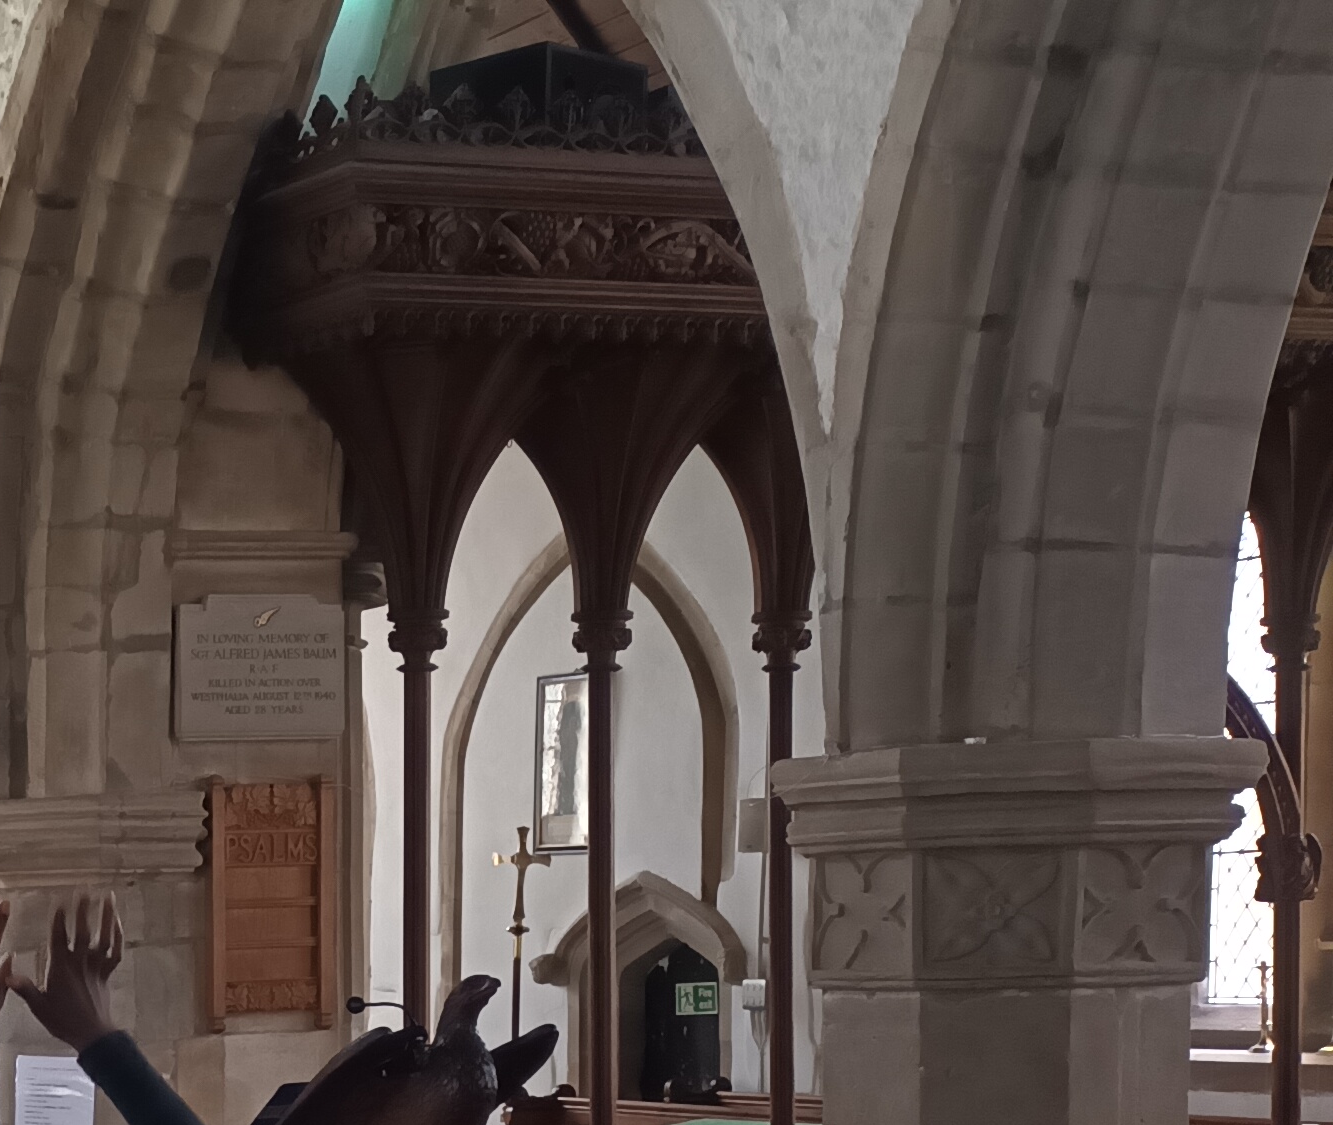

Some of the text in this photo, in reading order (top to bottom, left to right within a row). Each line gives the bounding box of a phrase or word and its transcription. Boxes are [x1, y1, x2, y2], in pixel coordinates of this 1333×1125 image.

[196, 632, 330, 644] IN LOVING MEMORY OF
[213, 648, 259, 659] ALFRED
[263, 648, 301, 662] JAMES
[303, 647, 337, 659] BAUM
[208, 677, 321, 688] KILLED IN ACTION OVER
[252, 691, 289, 701] AUGUST
[224, 705, 251, 715] AGED
[271, 705, 304, 714] YEARS
[226, 834, 318, 863] PSALMS
